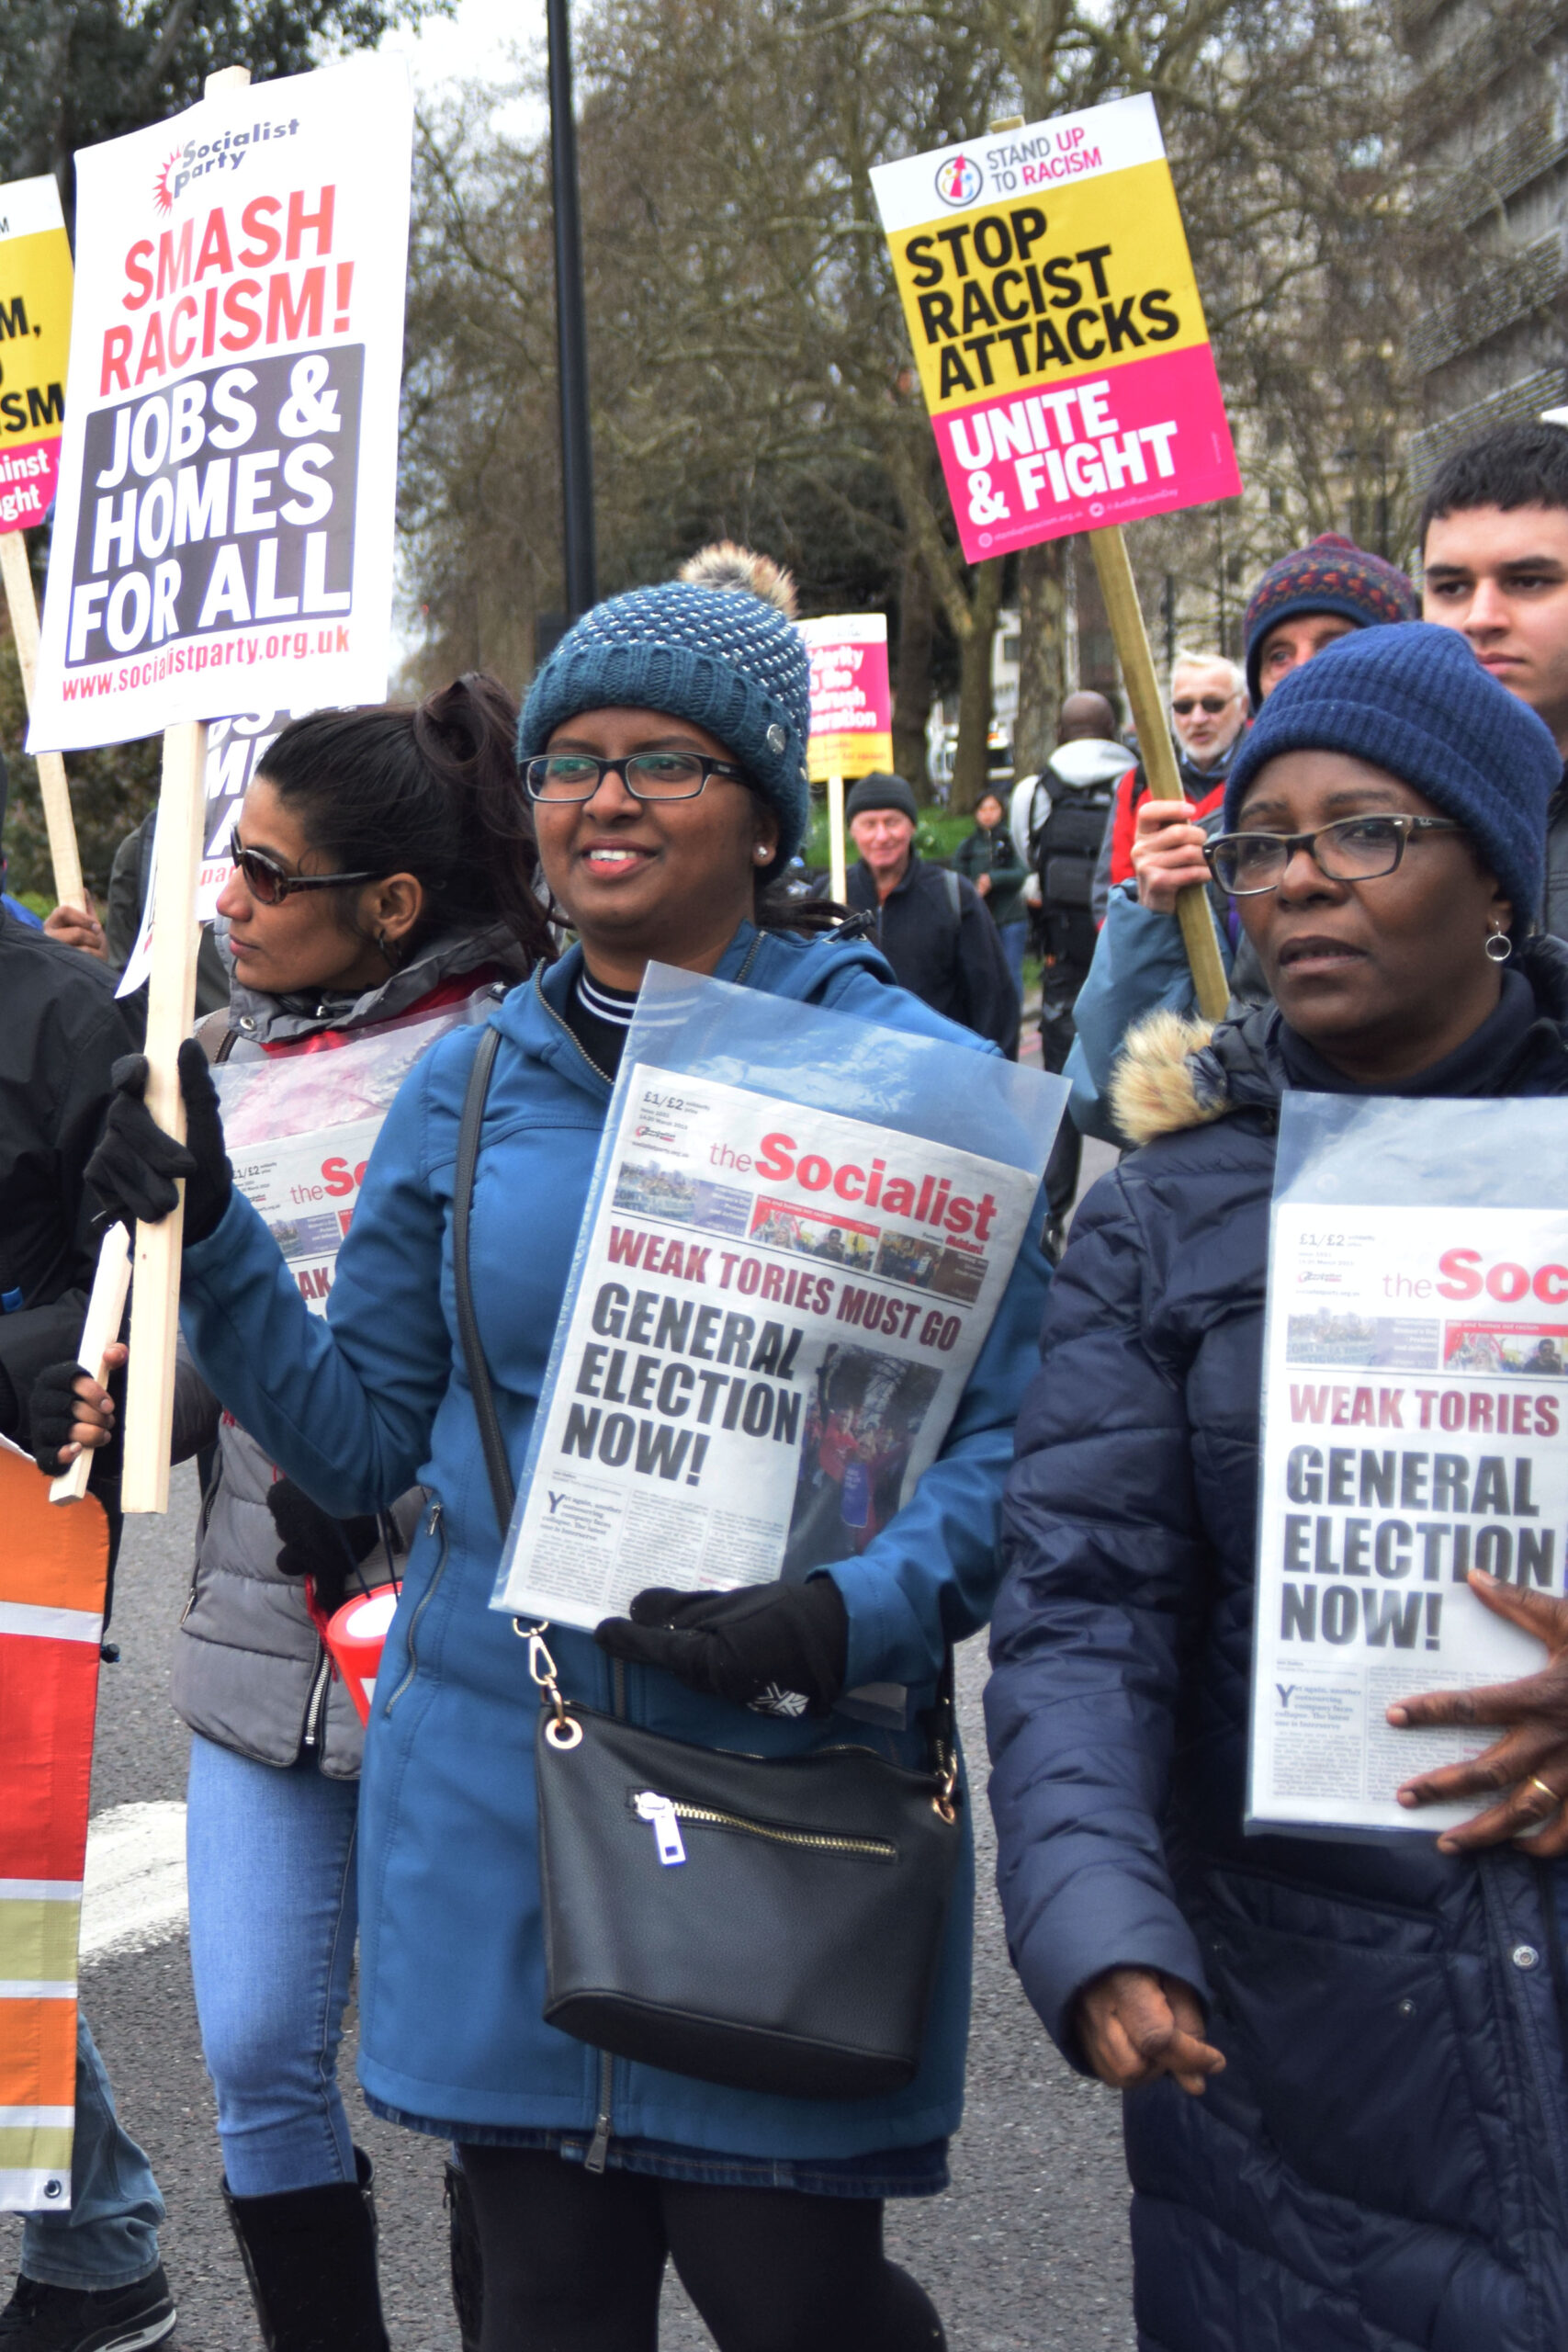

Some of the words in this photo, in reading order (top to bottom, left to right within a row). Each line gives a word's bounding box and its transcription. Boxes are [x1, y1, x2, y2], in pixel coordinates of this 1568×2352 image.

[183, 118, 299, 169] Socialist
[986, 136, 1050, 170] STAND
[1057, 127, 1086, 153] UP
[991, 170, 1018, 192] TO
[1021, 146, 1102, 187] RACISM
[121, 184, 336, 311] SMASH
[906, 206, 1048, 288] STOP
[99, 260, 355, 397] RACISM!
[918, 244, 1113, 345] RACIST
[939, 289, 1180, 400] ATTACKS
[96, 368, 258, 489] JOBS
[278, 355, 341, 438] &
[948, 380, 1119, 471] UNITE
[92, 442, 334, 574] HOMES
[967, 470, 1010, 526] &
[1014, 420, 1179, 512] FIGHT
[68, 559, 183, 662] FOR
[197, 530, 351, 628] ALL
[62, 624, 350, 702] www.socialistparty.org.uk
[643, 1091, 685, 1111] £1/£2
[290, 1184, 323, 1205] the
[709, 1142, 751, 1173] the
[755, 1132, 998, 1241] Socialist
[607, 1226, 712, 1283] WEAK
[719, 1251, 835, 1316] TORIES
[836, 1283, 922, 1341] MUST
[918, 1310, 962, 1352] GO
[1382, 1272, 1433, 1299] the
[592, 1283, 804, 1380] GENERAL
[574, 1342, 802, 1445] ELECTION
[1290, 1384, 1404, 1429] WEAK
[1415, 1388, 1560, 1438] TORIES
[560, 1402, 711, 1487] NOW!
[1286, 1443, 1540, 1517] GENERAL
[1283, 1513, 1555, 1588] ELECTION
[1280, 1582, 1443, 1651] NOW!
